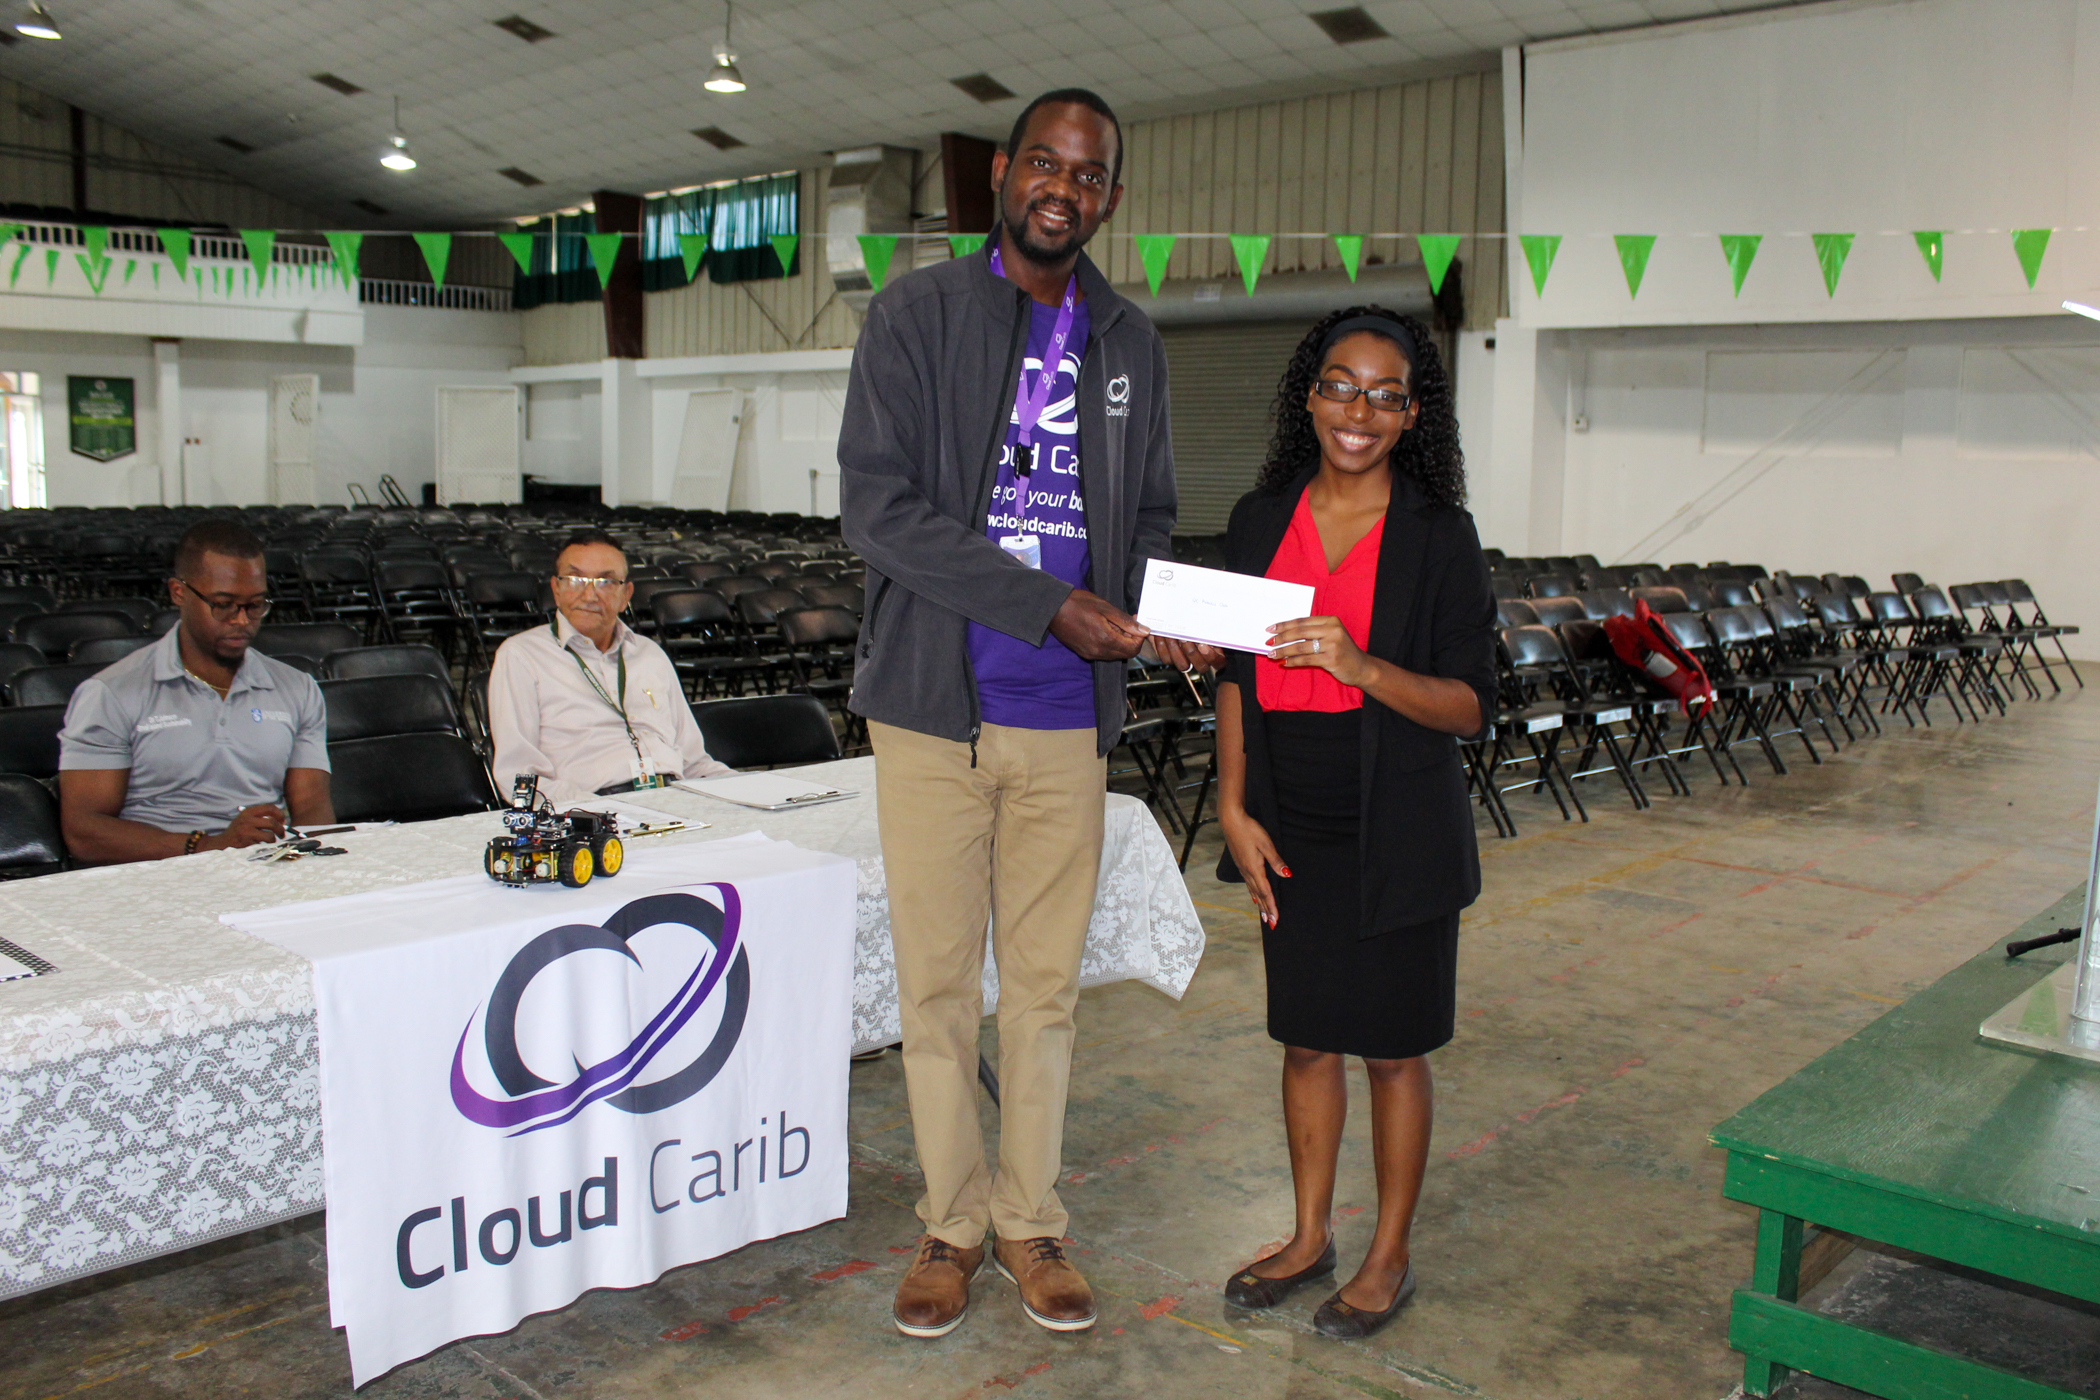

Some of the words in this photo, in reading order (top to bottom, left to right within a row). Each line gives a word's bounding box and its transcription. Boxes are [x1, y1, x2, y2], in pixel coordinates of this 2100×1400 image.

[1025, 490, 1068, 509] your
[396, 1156, 618, 1289] Cloud
[649, 1111, 811, 1214] Carib
